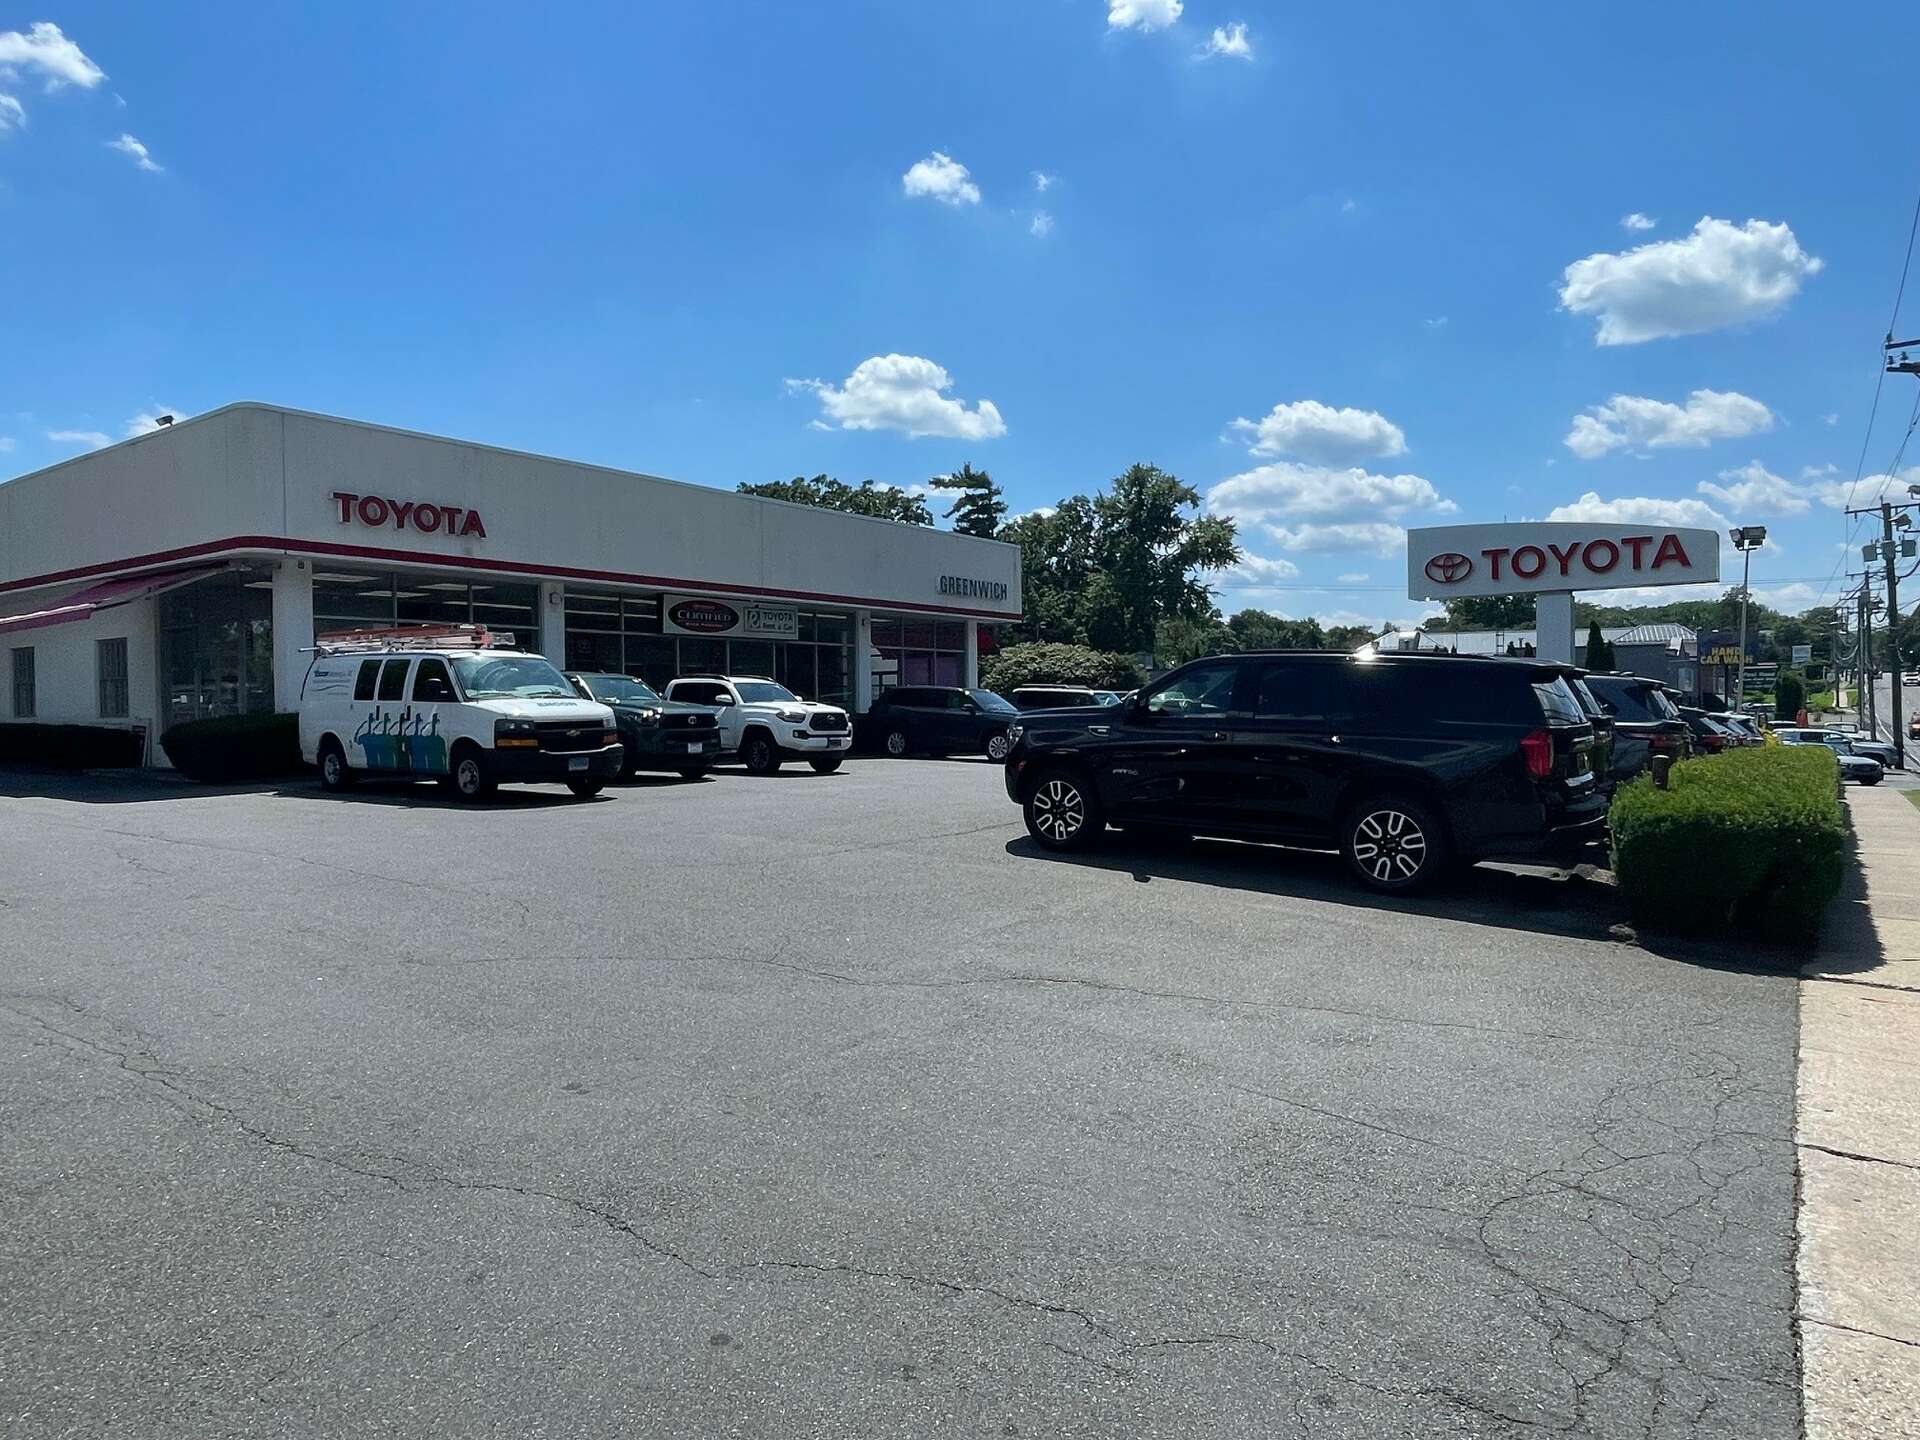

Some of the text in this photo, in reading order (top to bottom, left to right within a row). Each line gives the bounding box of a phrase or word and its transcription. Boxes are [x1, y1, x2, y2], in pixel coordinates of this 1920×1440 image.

[332, 491, 486, 539] TOYOTA
[1481, 534, 1692, 580] TOYOTA
[939, 575, 1008, 601] GREENWICH
[763, 611, 793, 622] TOYOTA
[1700, 655, 1753, 665] CAR WAH
[1711, 646, 1741, 656] HAND
